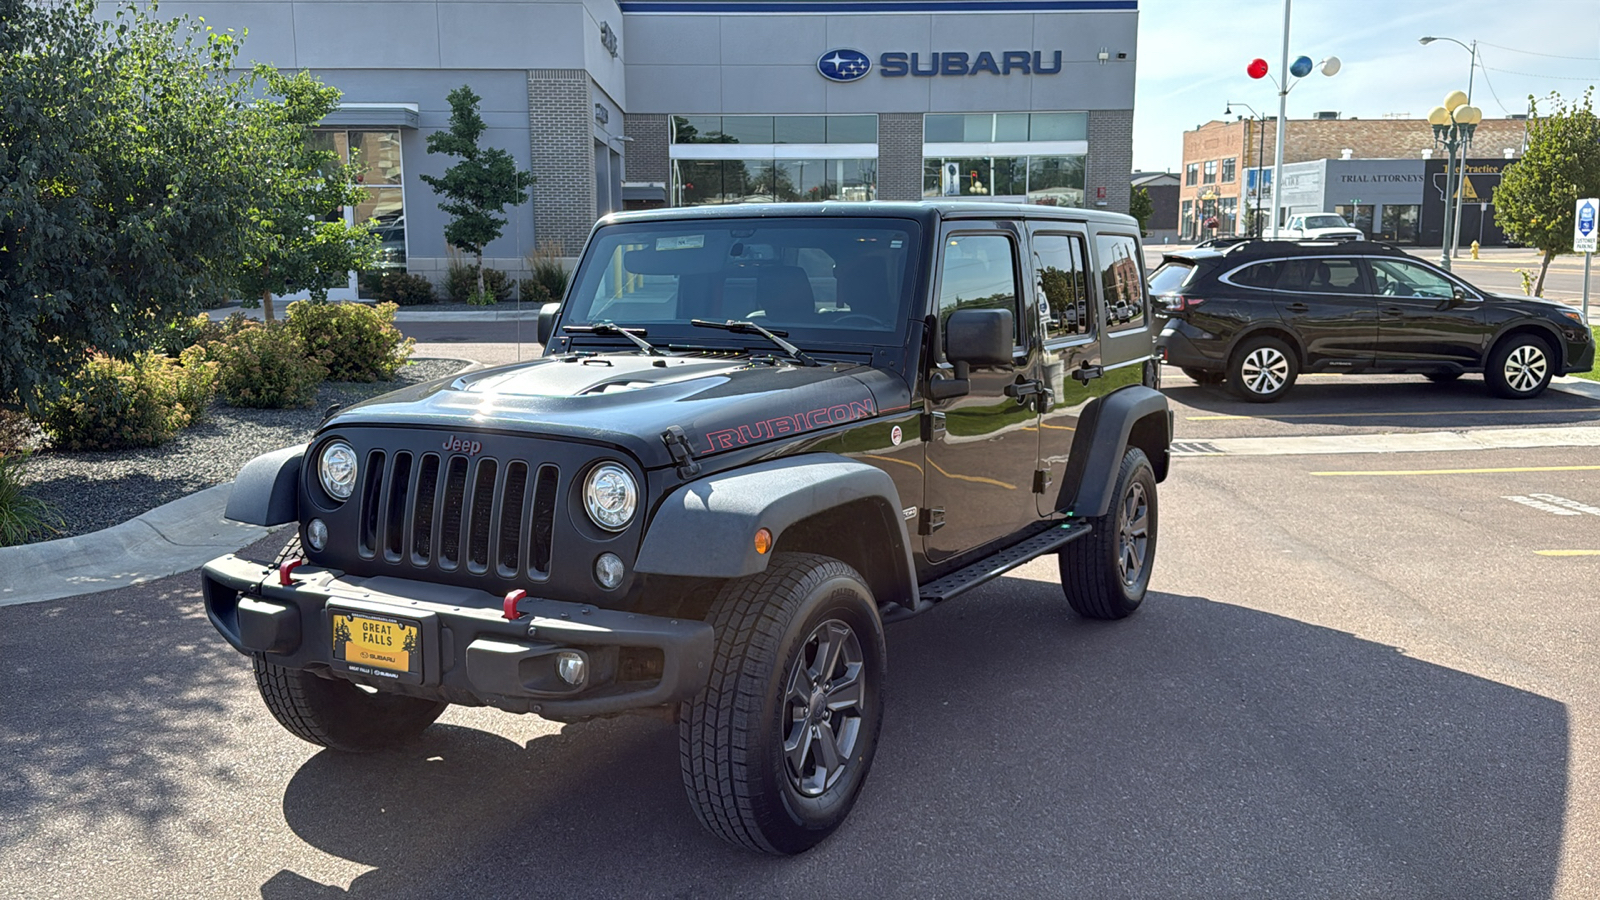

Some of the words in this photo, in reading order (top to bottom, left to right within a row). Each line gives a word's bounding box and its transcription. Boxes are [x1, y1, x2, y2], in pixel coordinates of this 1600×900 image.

[880, 50, 1063, 77] SUBARU
[1443, 164, 1460, 173] Te
[1463, 164, 1499, 173] Practice
[1341, 174, 1369, 183] TRIAL
[1370, 174, 1424, 183] ATTORNEYS
[701, 398, 876, 454] RUBICON
[442, 434, 482, 457] Jeep
[362, 621, 392, 635] GREAT
[362, 632, 393, 647] FALLS
[369, 653, 396, 663] SUBARU
[379, 671, 399, 679] SUBARU
